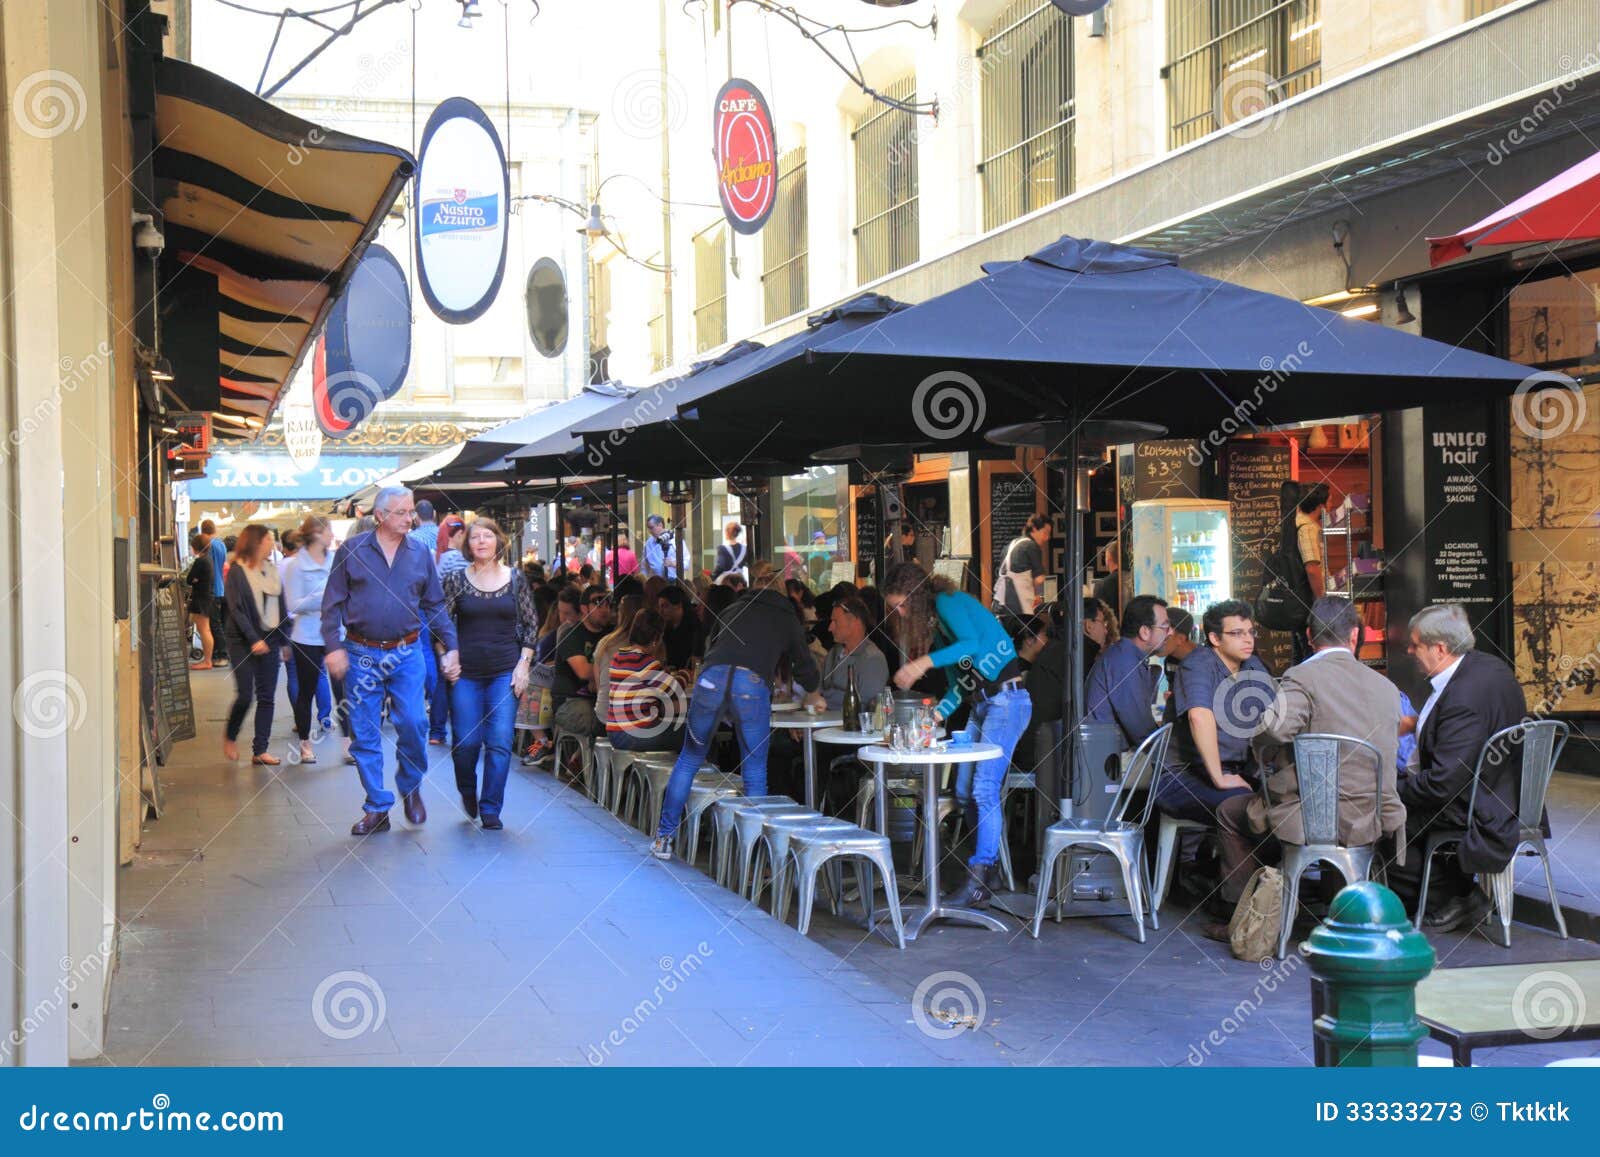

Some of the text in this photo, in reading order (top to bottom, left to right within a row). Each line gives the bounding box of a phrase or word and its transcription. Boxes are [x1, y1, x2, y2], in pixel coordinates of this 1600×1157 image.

[440, 203, 483, 217] Nastro
[433, 212, 486, 226] Azzurro
[1432, 432, 1487, 447] UNICO
[1442, 447, 1479, 464] hair
[213, 468, 299, 487] JACK
[1447, 475, 1475, 483] AWARD
[1443, 485, 1478, 493] WINNING
[1446, 494, 1476, 503] SALONS
[1448, 551, 1476, 559] Degraves
